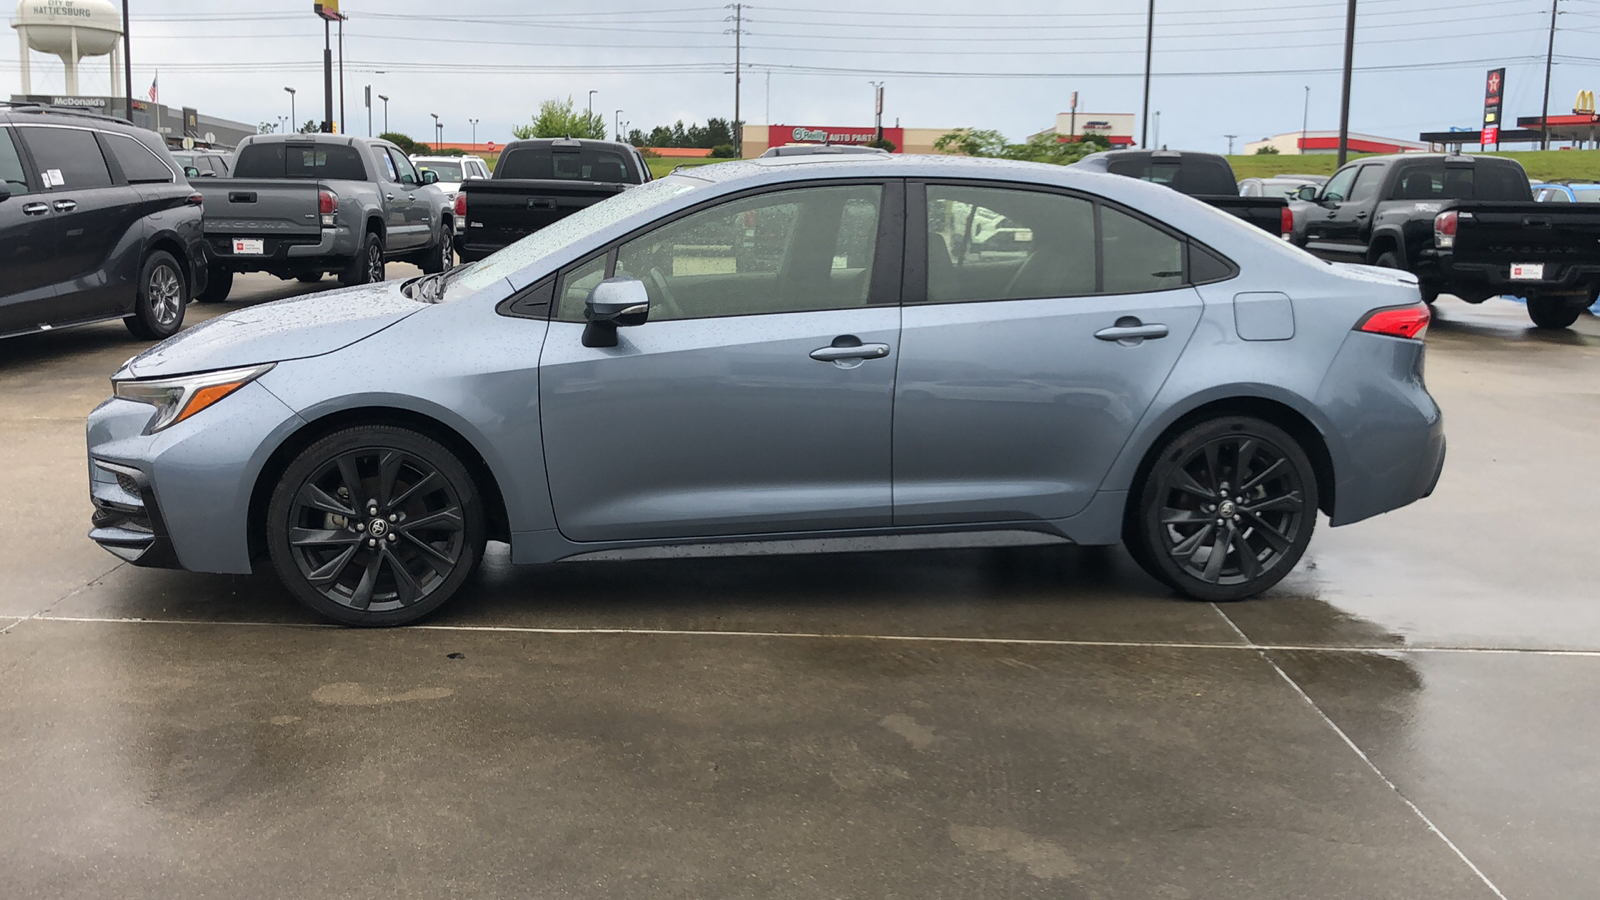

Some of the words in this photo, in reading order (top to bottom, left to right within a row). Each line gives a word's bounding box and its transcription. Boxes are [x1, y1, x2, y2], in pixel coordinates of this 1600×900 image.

[33, 6, 91, 17] HATTIESBURG
[54, 97, 105, 107] McDonald's
[828, 133, 851, 142] AUTO
[203, 221, 290, 229] TACOMA
